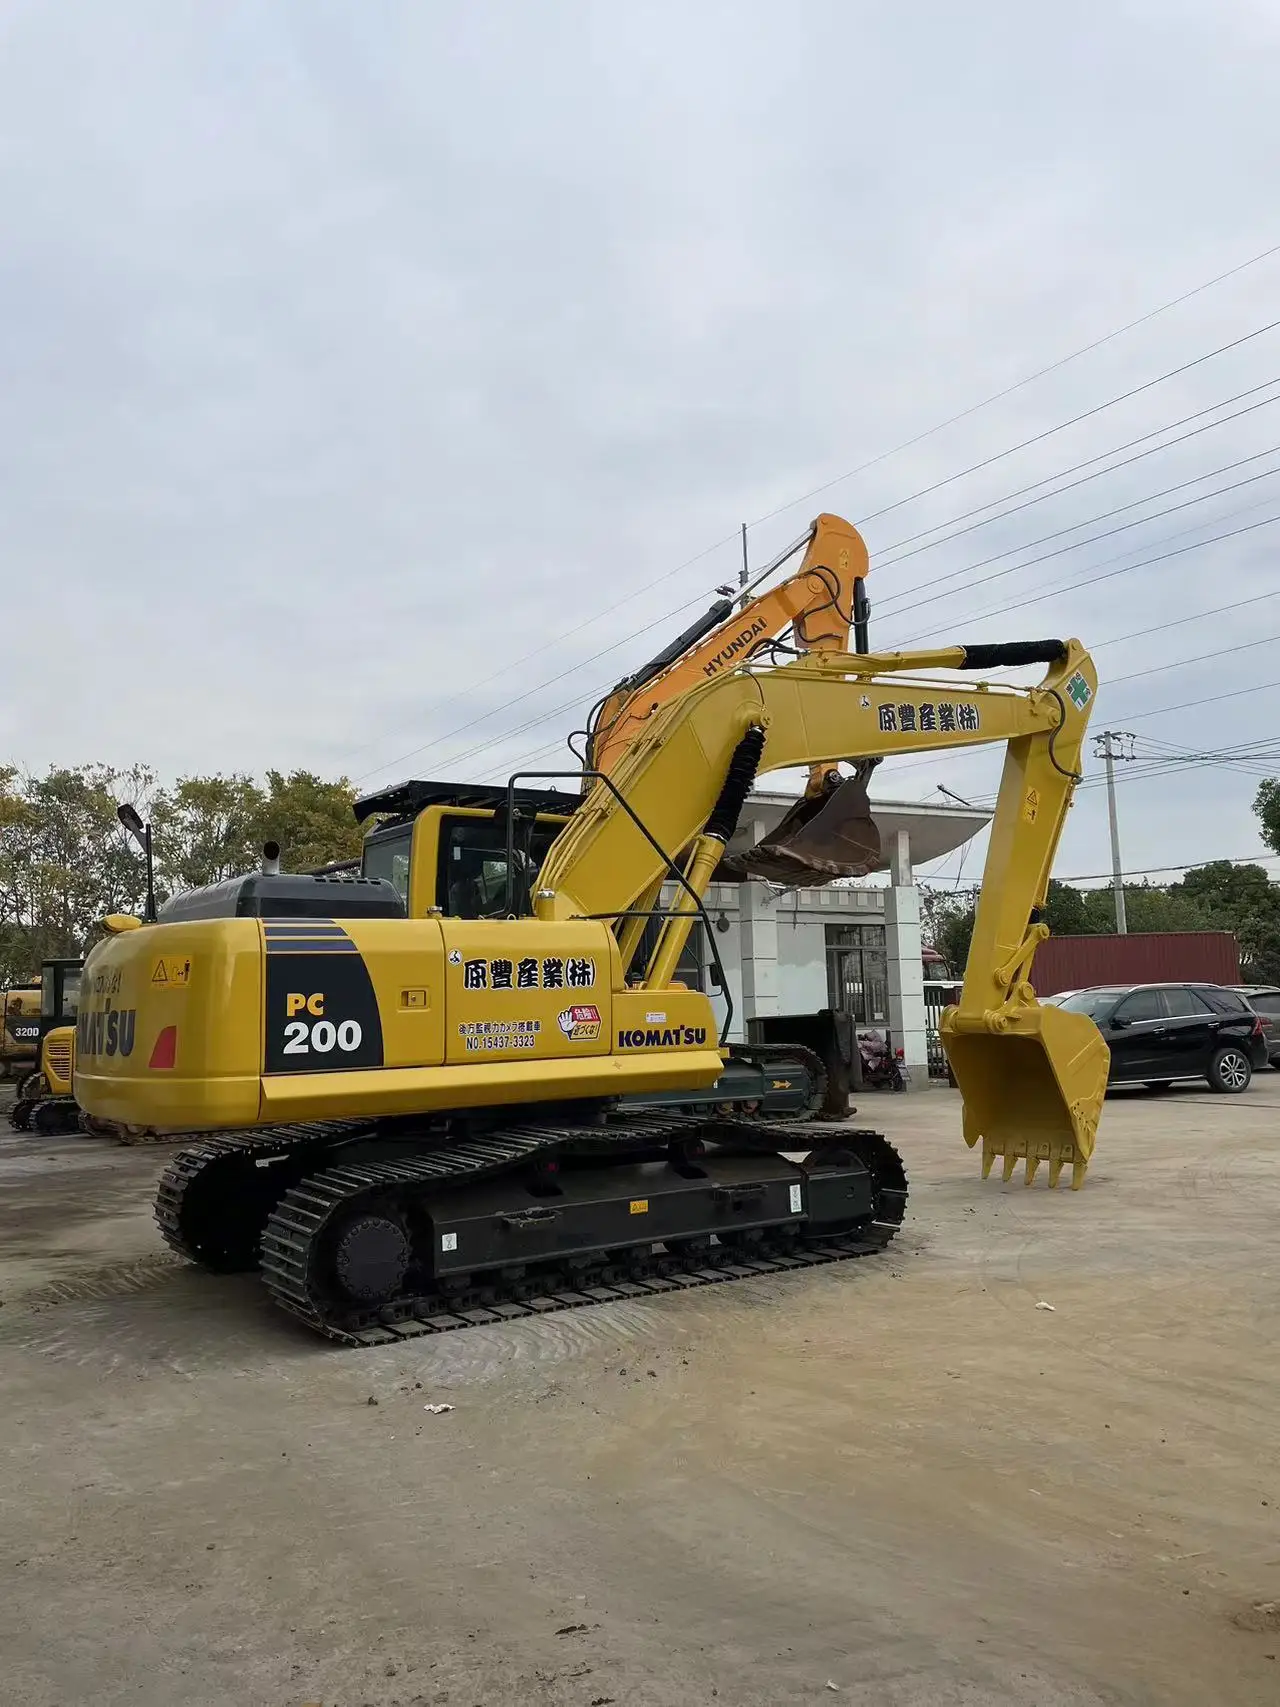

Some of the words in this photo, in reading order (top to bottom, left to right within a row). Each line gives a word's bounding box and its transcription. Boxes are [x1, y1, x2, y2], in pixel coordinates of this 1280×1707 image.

[703, 617, 768, 677] HYUNDAI
[286, 992, 324, 1017] PC
[15, 1027, 40, 1037] 320D
[79, 998, 137, 1057] MATSU
[283, 1019, 363, 1055] 200
[618, 1024, 706, 1048] KOMATSU
